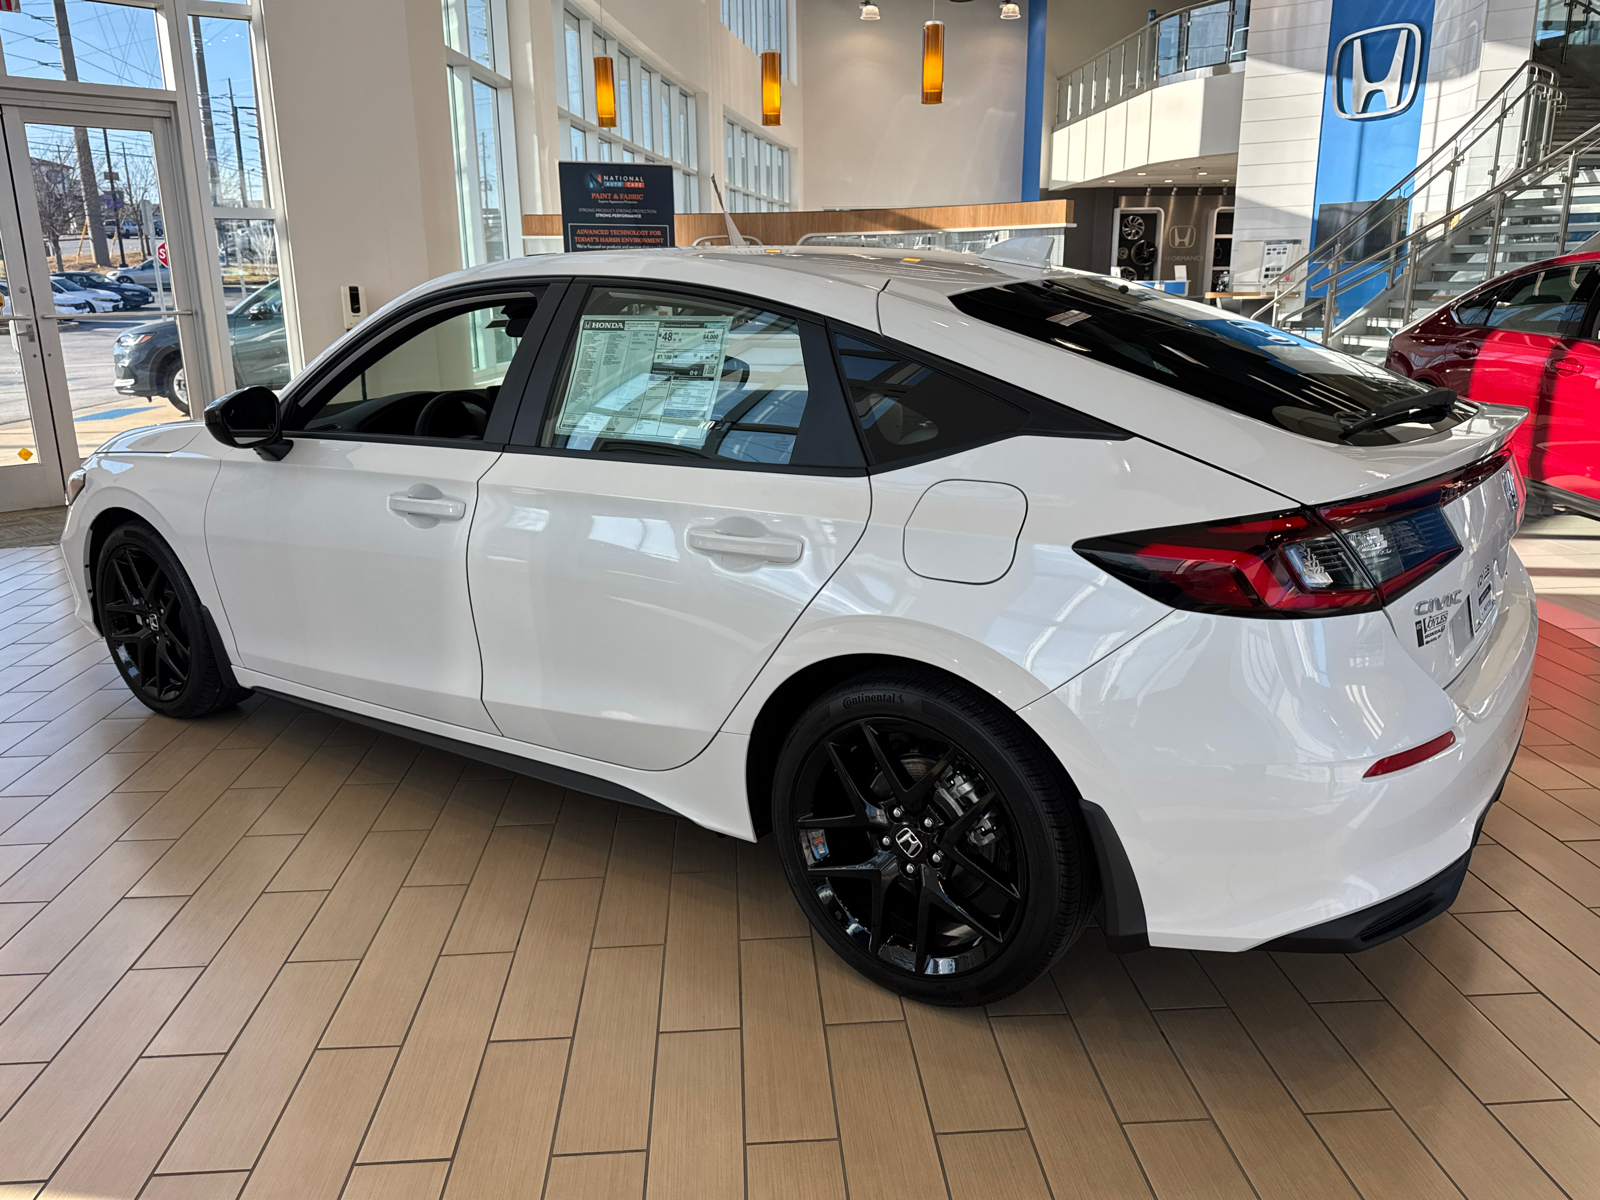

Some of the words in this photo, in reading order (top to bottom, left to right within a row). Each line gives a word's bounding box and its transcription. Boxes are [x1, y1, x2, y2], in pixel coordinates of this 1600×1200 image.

[662, 332, 673, 341] 48
[1414, 589, 1462, 616] CIVIC
[843, 693, 896, 709] Continental
